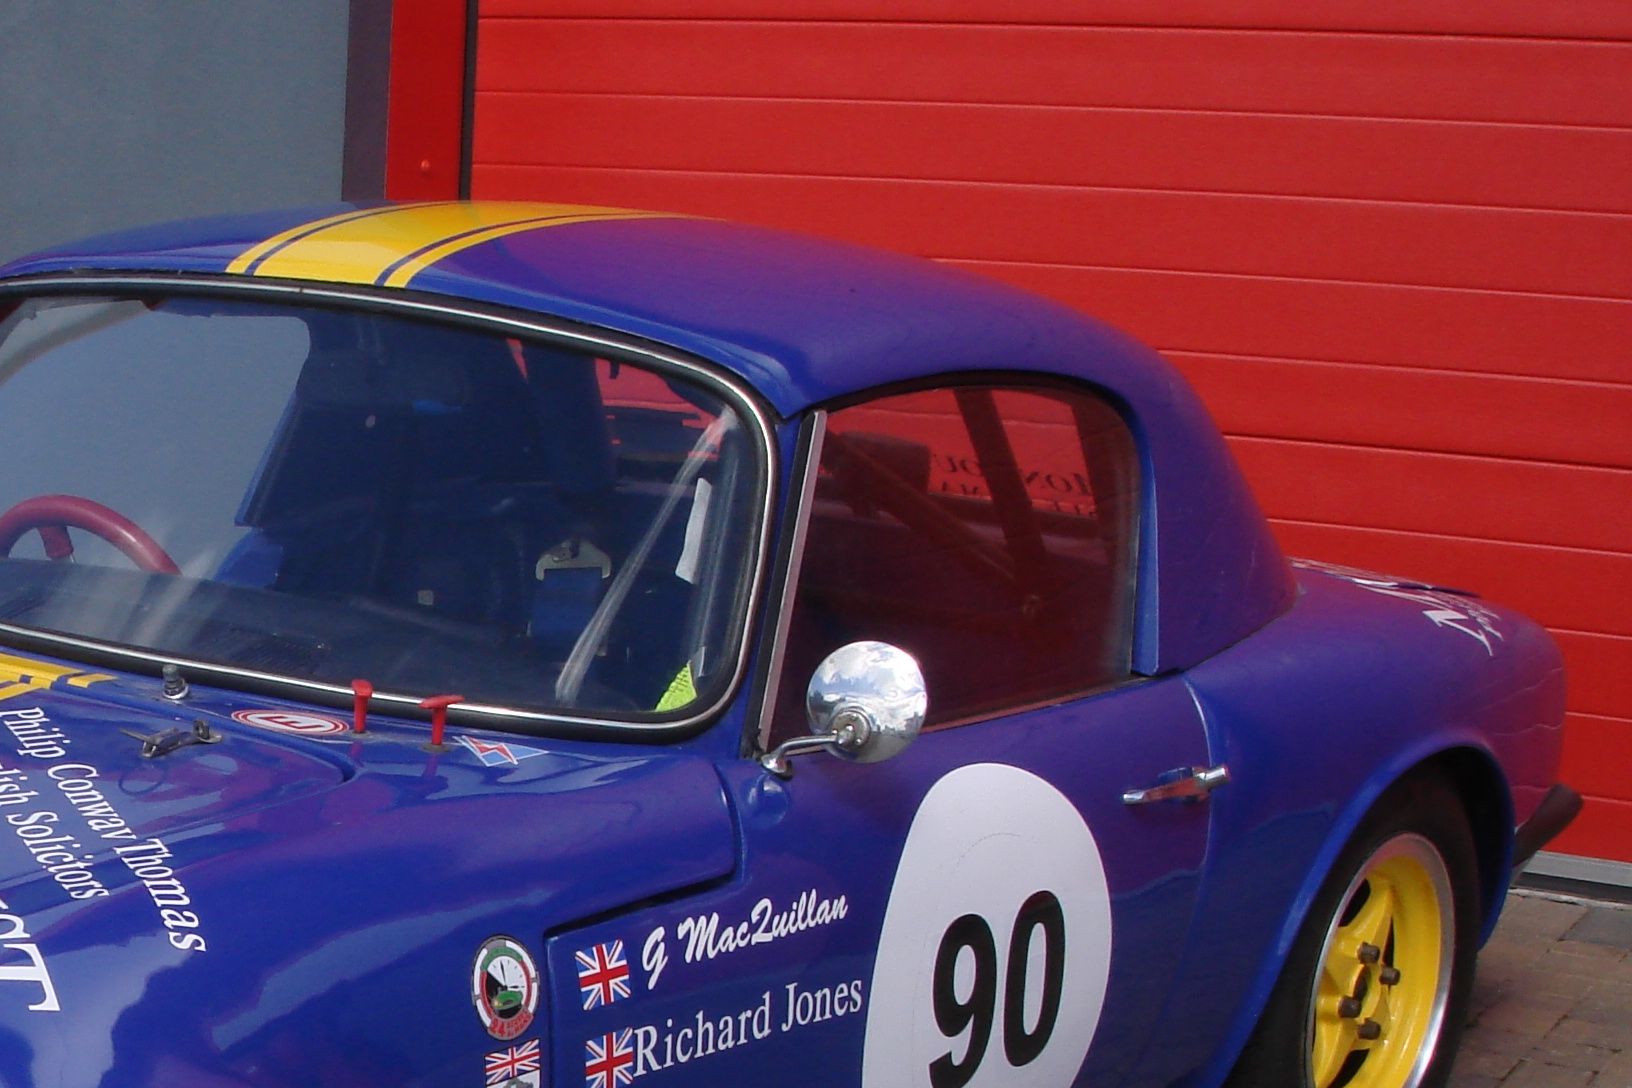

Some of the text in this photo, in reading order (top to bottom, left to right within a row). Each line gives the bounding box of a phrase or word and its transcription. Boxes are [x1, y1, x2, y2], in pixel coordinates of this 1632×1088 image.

[6, 811, 110, 899] Solicitors
[114, 838, 206, 952] Thomas
[677, 888, 848, 964] MacQuillan
[632, 975, 862, 1078] Richard Jones
